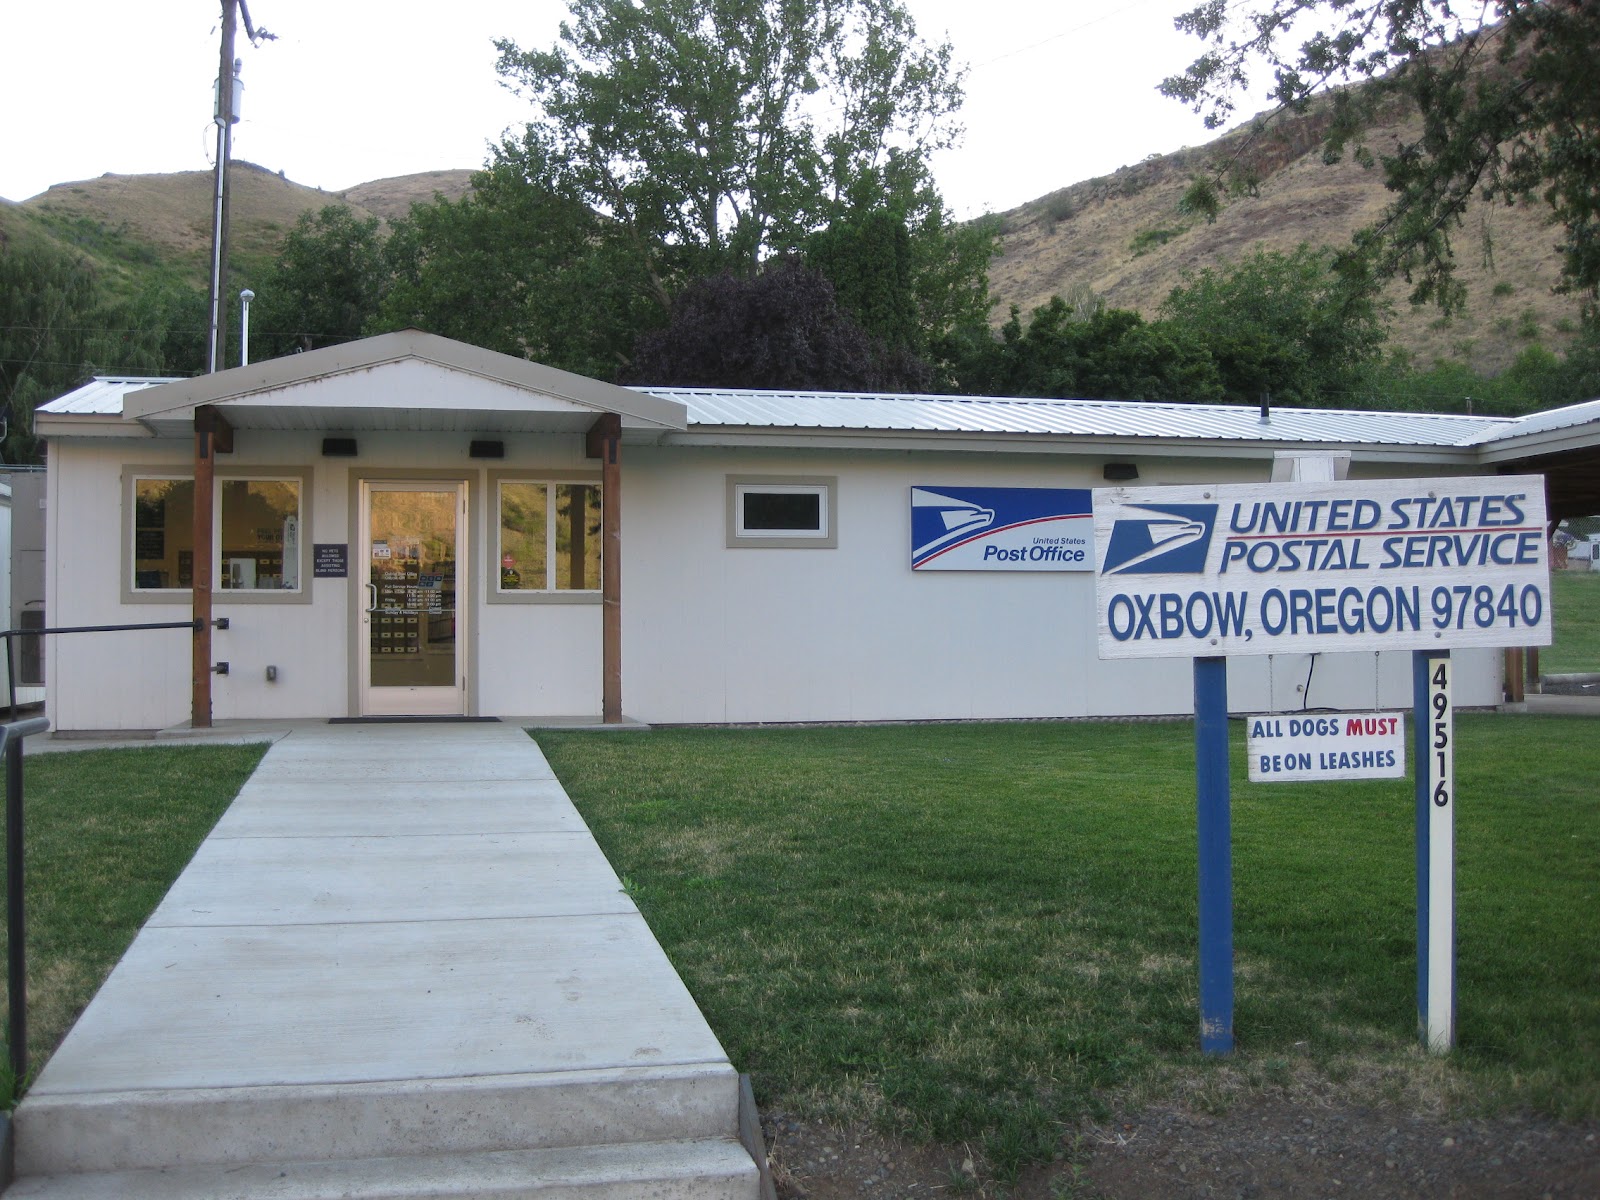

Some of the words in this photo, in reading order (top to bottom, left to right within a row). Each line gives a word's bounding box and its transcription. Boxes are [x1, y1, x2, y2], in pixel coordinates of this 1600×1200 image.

[1229, 498, 1382, 534] UNITED
[1387, 493, 1527, 531] STATES
[983, 545, 1027, 561] Post
[1029, 545, 1085, 562] Office
[1032, 537, 1059, 545] United
[1060, 537, 1086, 545] States
[1218, 537, 1370, 574] POSTAL
[1380, 532, 1543, 569] SERVICE
[1108, 590, 1253, 643] OXBOW,
[1260, 585, 1421, 637] OREGON
[1431, 583, 1542, 630] 97840
[1252, 720, 1283, 738] ALL
[1289, 718, 1339, 737] DOGS
[1346, 718, 1398, 736] MUST
[1432, 663, 1448, 807] 49516
[1320, 749, 1396, 770] LEASHES
